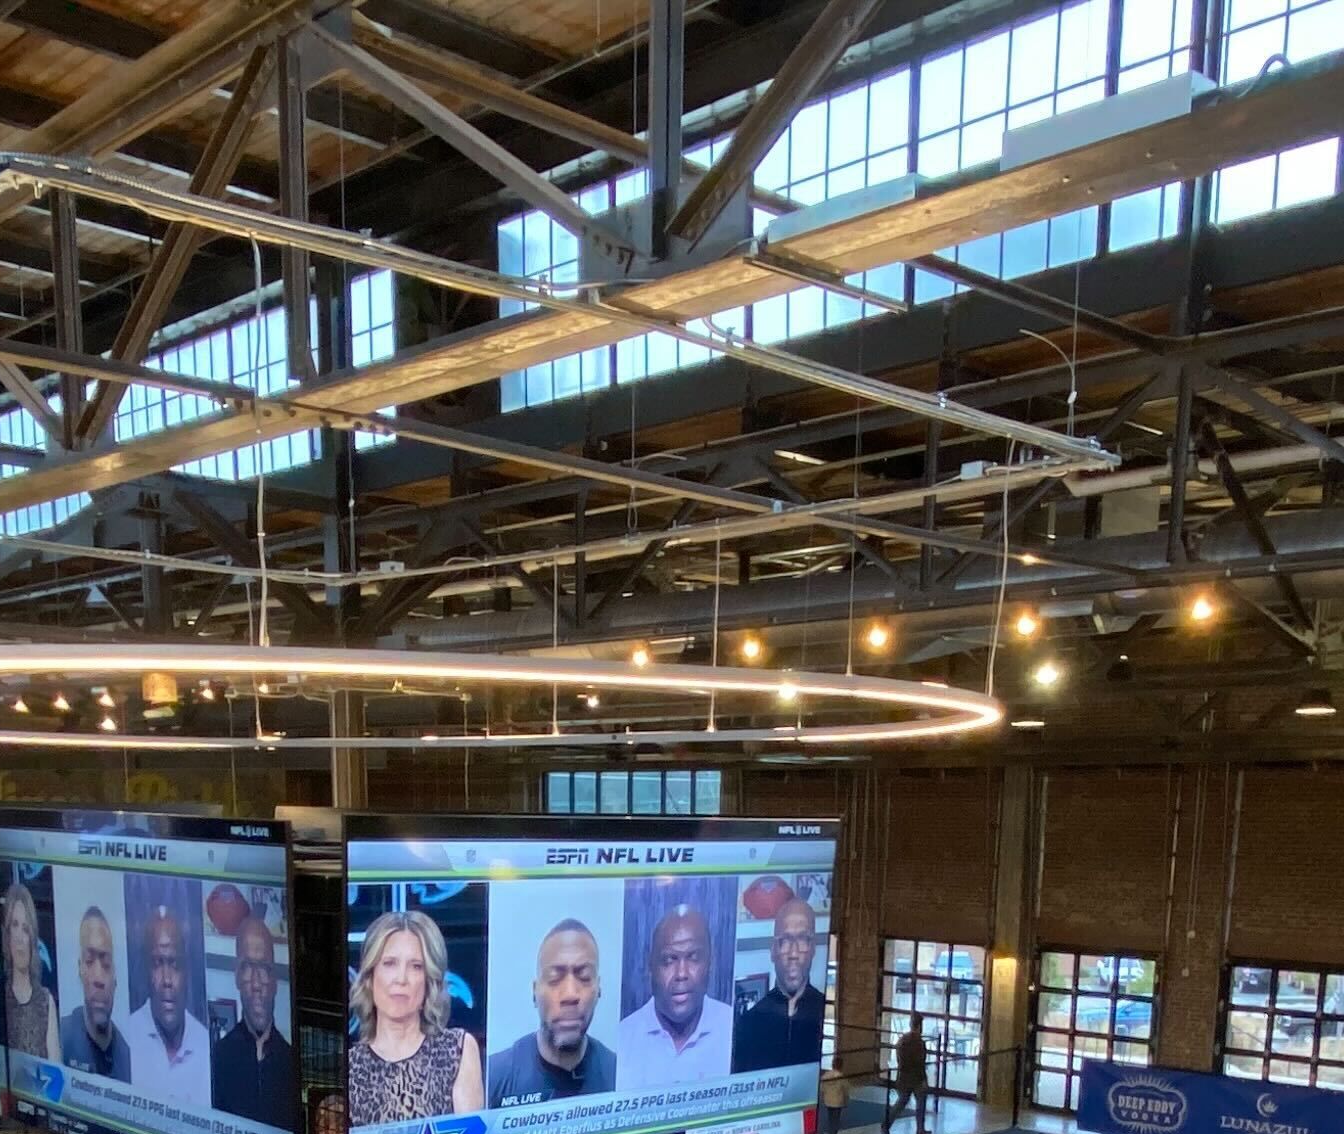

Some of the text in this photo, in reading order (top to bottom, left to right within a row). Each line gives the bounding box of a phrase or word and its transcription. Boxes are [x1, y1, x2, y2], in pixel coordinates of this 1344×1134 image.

[802, 825, 822, 835] LIVE
[78, 839, 167, 861] ESPN NFL LIVE
[545, 847, 695, 865] ESPN NFL LIVE
[501, 1092, 542, 1107] NFL LIVE
[502, 1075, 791, 1130] Cowboys: allowed 27.5 PPG last season (31st in NFL)
[1117, 1094, 1178, 1115] DEEP EDDY
[1120, 1110, 1172, 1125] VODKA
